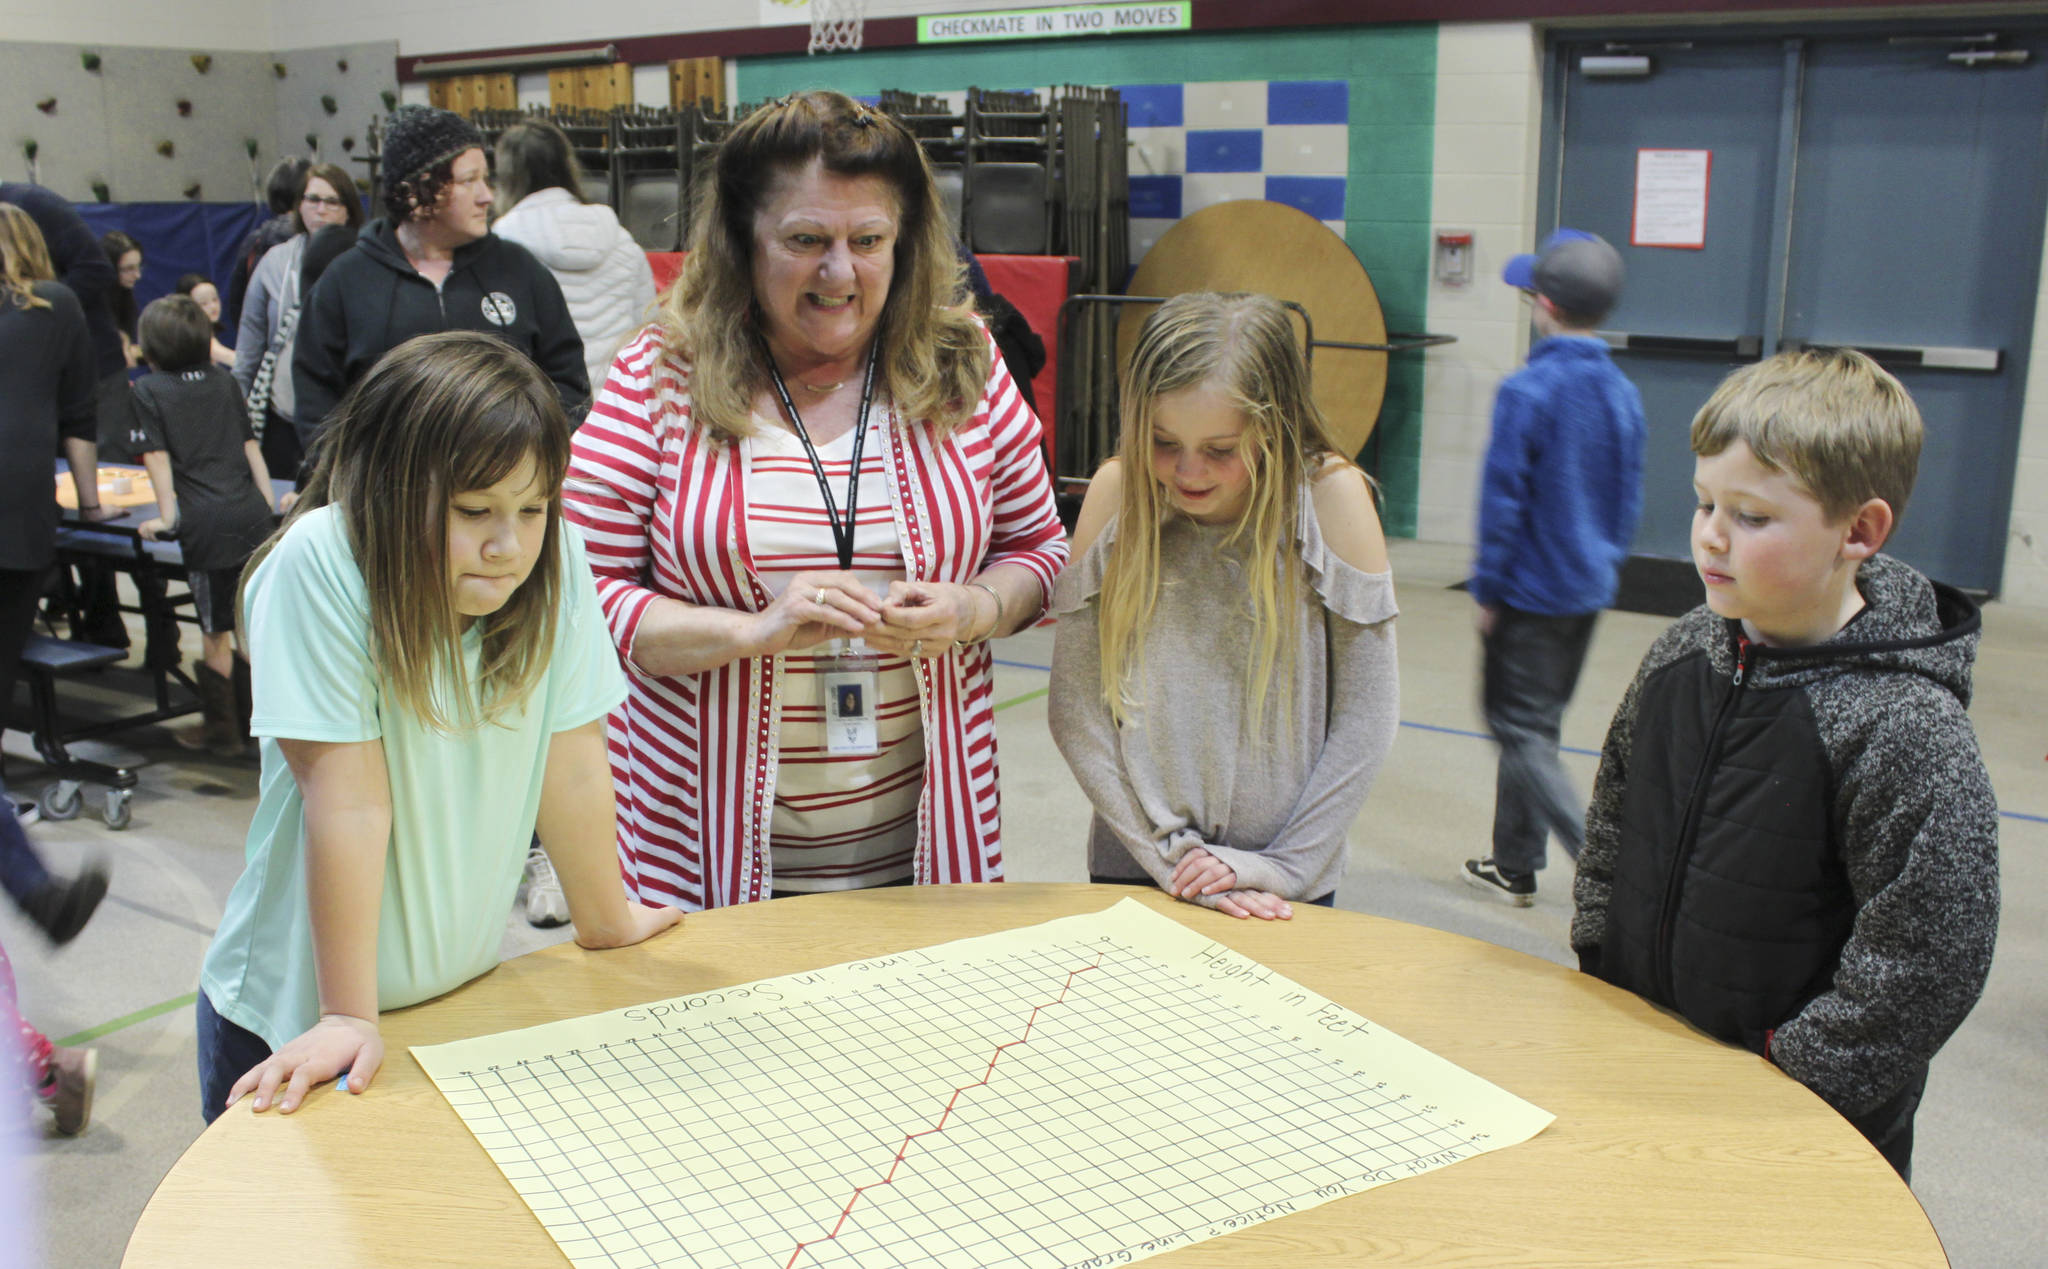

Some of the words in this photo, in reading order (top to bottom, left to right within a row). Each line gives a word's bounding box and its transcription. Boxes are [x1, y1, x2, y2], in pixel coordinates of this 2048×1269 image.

[931, 16, 1025, 37] CHECKMATE
[1036, 15, 1053, 32] IN
[1064, 12, 1104, 30] TWO
[1114, 7, 1177, 26] MOVES
[848, 950, 945, 973] Time
[791, 972, 832, 986] in
[1190, 942, 1275, 987] Height
[1279, 988, 1307, 1008] in
[1306, 1002, 1370, 1038] Feet
[624, 983, 784, 1029] Seconds
[1406, 1149, 1466, 1175] What
[1362, 1169, 1398, 1182] Do
[1313, 1182, 1357, 1198] You
[1140, 1231, 1195, 1251] Line
[1073, 1250, 1132, 1269] Grap
